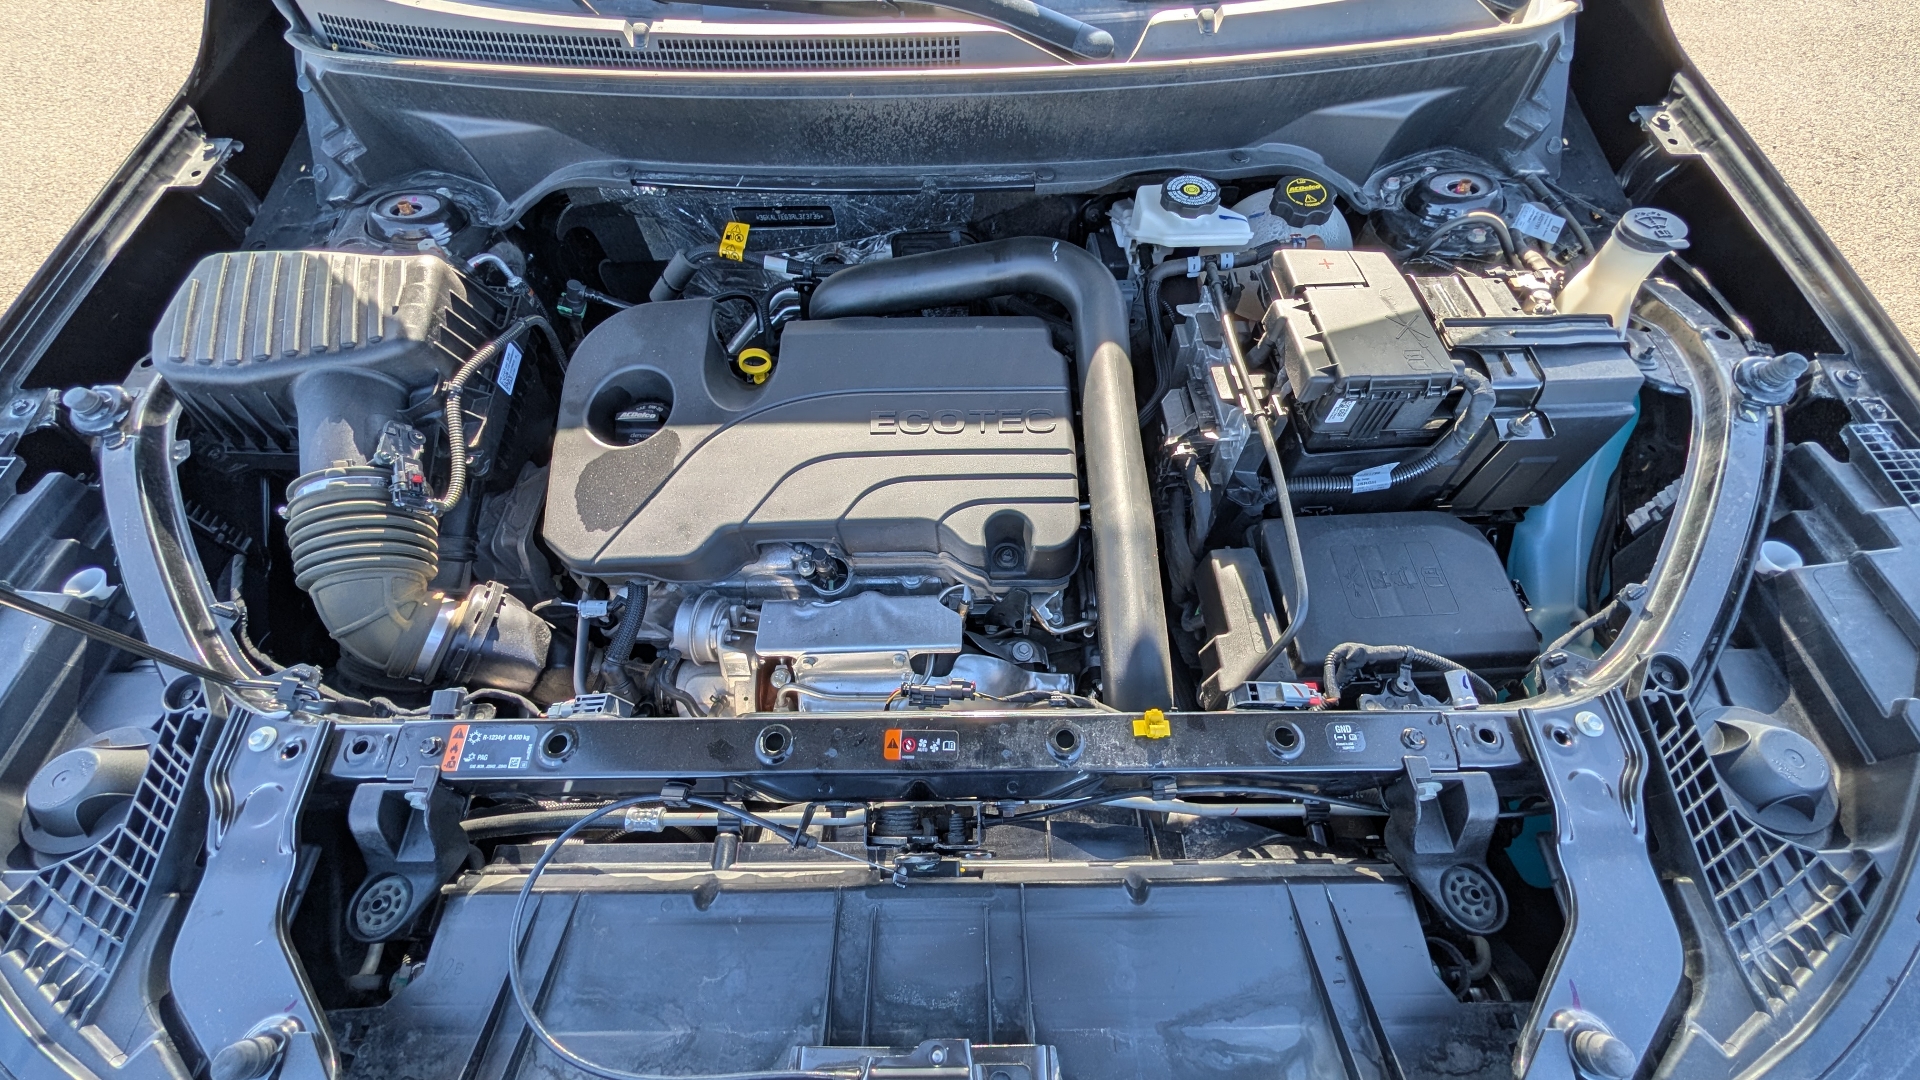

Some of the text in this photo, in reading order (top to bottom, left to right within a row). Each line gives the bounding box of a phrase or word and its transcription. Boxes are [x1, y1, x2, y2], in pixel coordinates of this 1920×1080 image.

[618, 411, 656, 420] ACDelco
[870, 408, 1057, 435] ECOTEC
[1335, 724, 1352, 733] GND
[523, 734, 531, 742] kg
